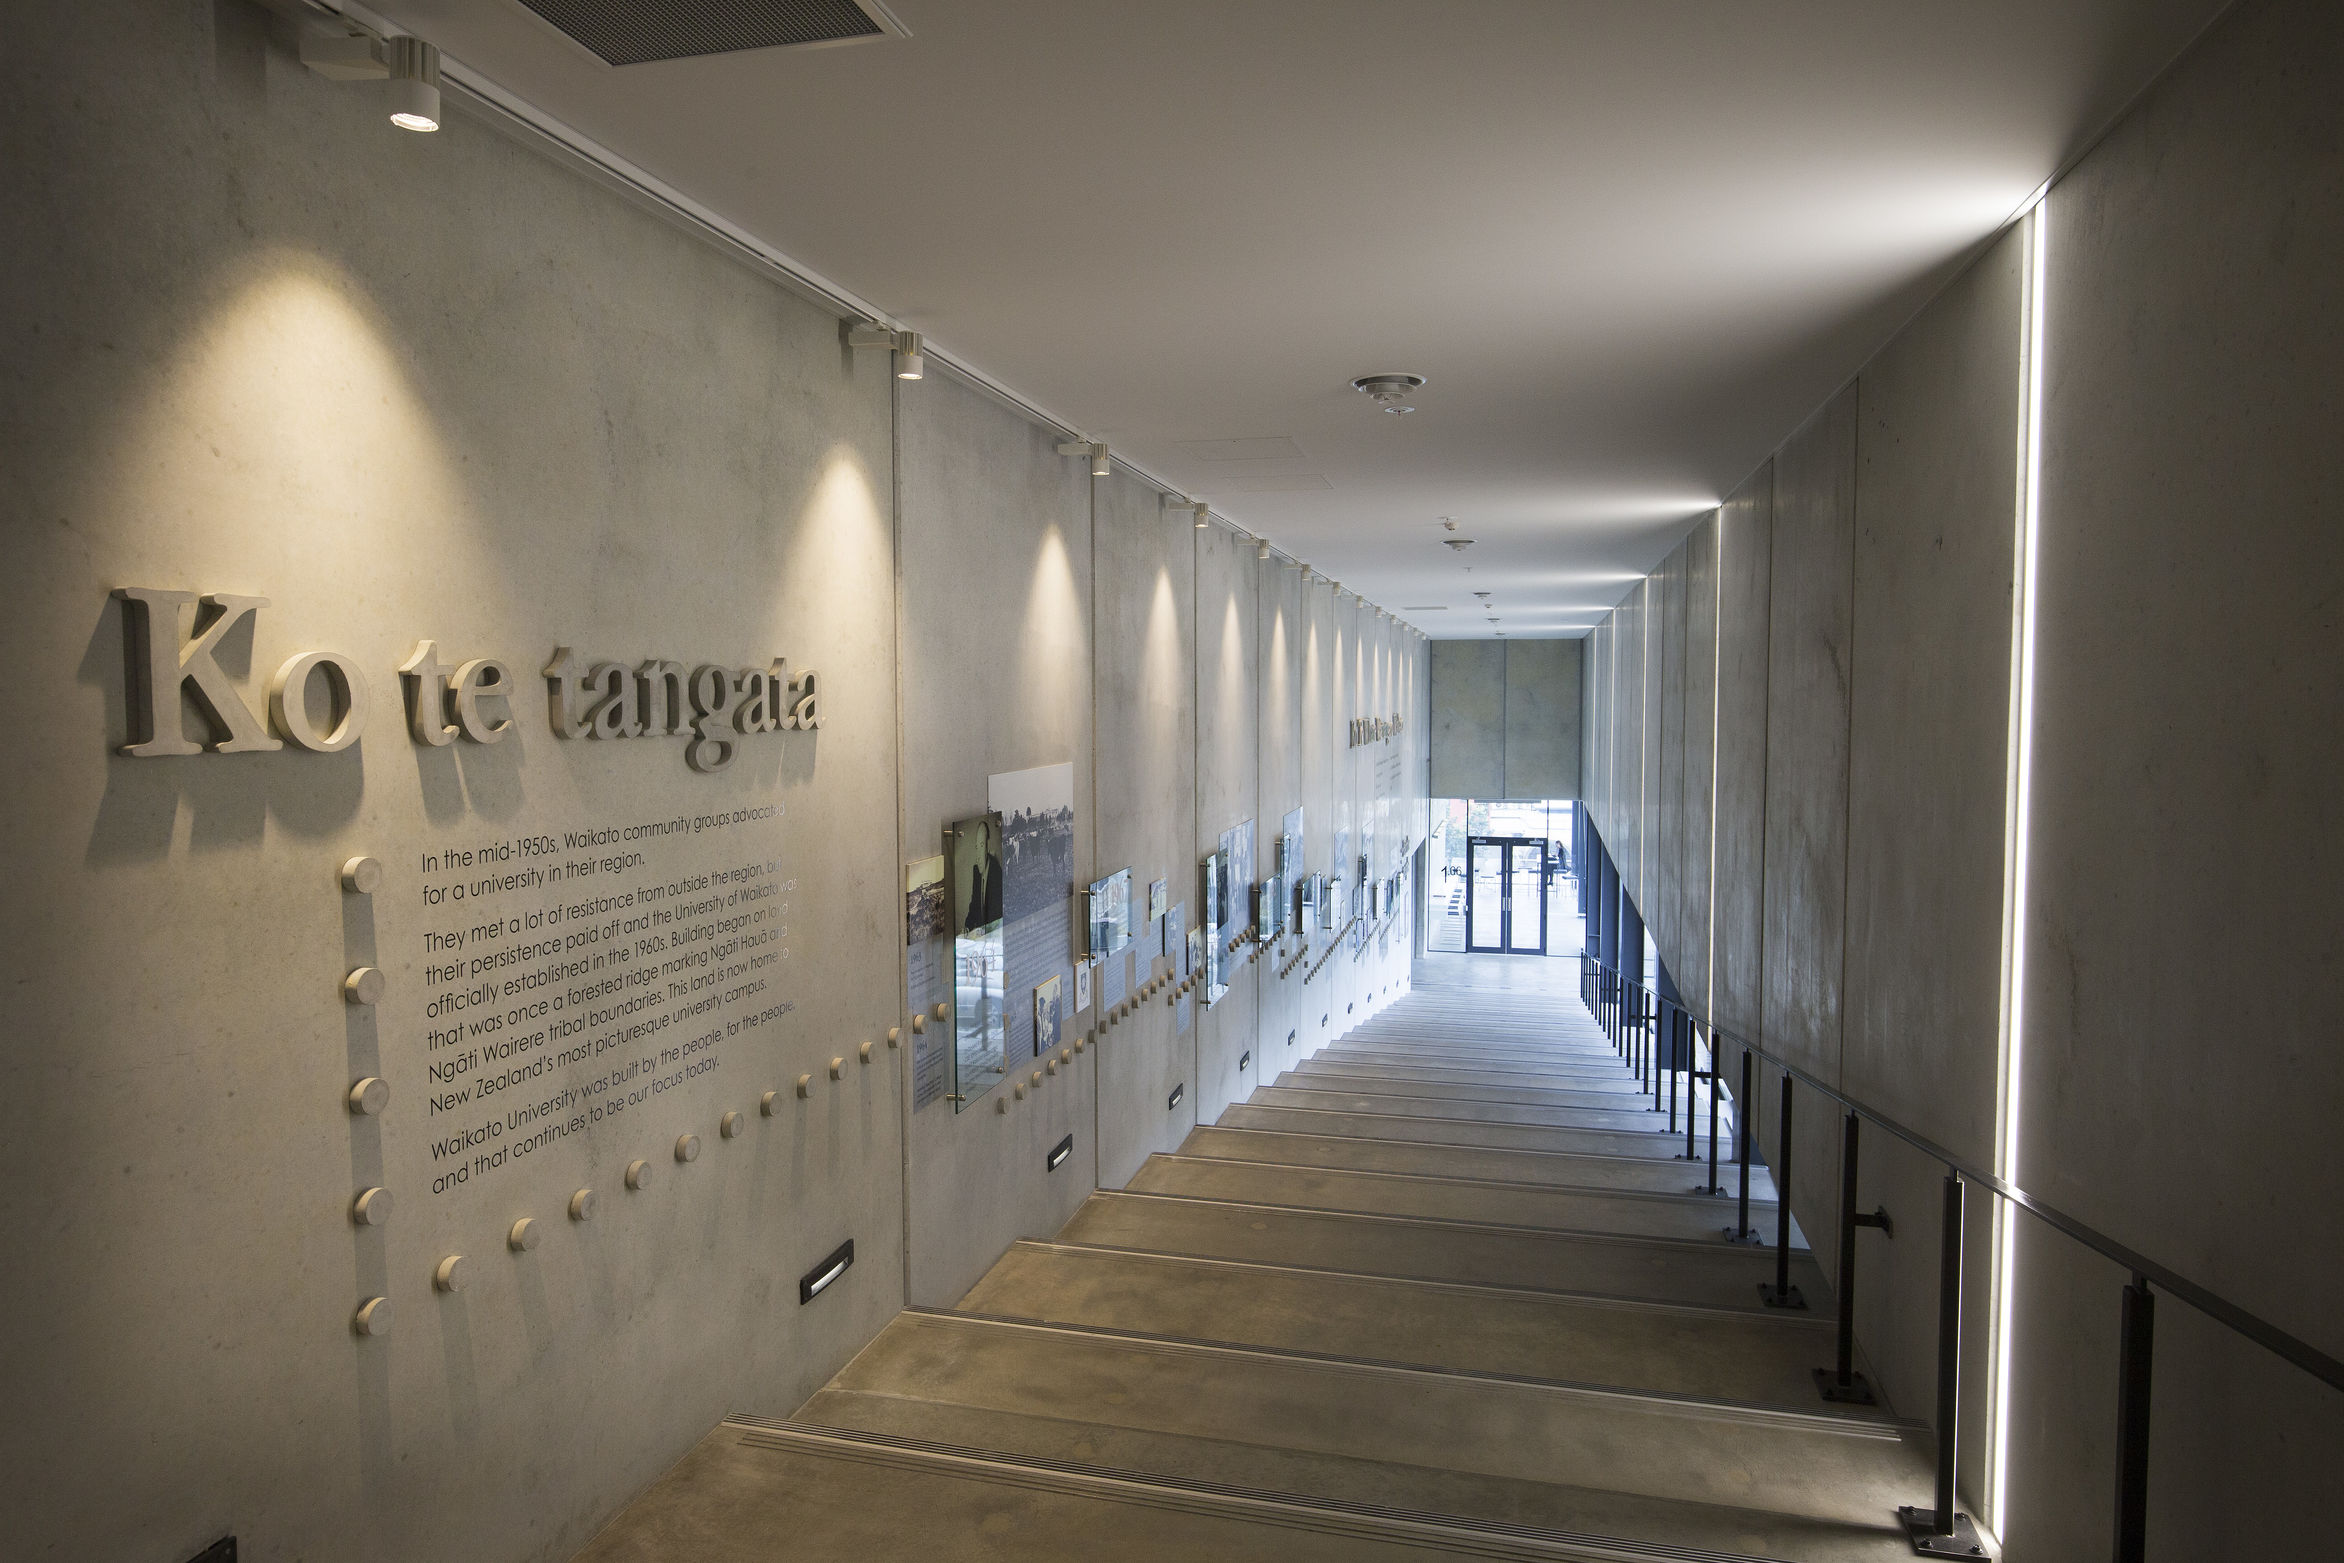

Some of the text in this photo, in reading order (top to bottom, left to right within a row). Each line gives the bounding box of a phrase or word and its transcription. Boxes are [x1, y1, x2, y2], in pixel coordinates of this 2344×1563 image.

[110, 586, 827, 772] Ko te tangata
[422, 801, 785, 873] In the mid-1950s, Waikato community groups advocated
[423, 851, 645, 906] for a university in their region.
[423, 930, 466, 953] They
[471, 917, 504, 943] met
[509, 918, 520, 933] a
[525, 909, 543, 930] lot
[548, 904, 563, 925] of
[567, 893, 634, 920] resistance
[637, 885, 665, 904] from
[668, 874, 709, 897] outside
[712, 871, 729, 886] the
[731, 863, 764, 883] region,
[426, 959, 466, 986] their
[471, 938, 561, 979] persistence
[566, 924, 598, 953] paid
[602, 919, 620, 940] off
[623, 915, 649, 934] and
[652, 909, 672, 926] the
[675, 895, 725, 920] University
[727, 890, 738, 908] of
[740, 882, 778, 903] Waikato
[427, 982, 499, 1018] officially
[504, 955, 589, 996] established
[593, 953, 605, 970] in
[608, 948, 630, 966] the
[635, 936, 668, 958] 1960s.
[671, 923, 714, 947] Building
[717, 914, 751, 933] began
[754, 909, 765, 923] on
[427, 1022, 464, 1051] that
[469, 1014, 502, 1037] was
[507, 1000, 548, 1026] once
[553, 996, 563, 1011] a
[567, 973, 622, 1006] forested
[626, 966, 659, 986] ridge
[662, 951, 708, 977] marking
[710, 937, 739, 961] Ngāti
[741, 930, 767, 951] Hauā
[429, 1049, 478, 1084] Ngāti
[483, 1031, 544, 1063] Wairere
[549, 1012, 586, 1042] tribal
[589, 990, 665, 1027] boundaries.
[668, 980, 688, 999] This
[690, 969, 715, 991] land
[717, 967, 725, 981] is
[727, 962, 749, 979] now
[750, 951, 778, 970] home
[430, 978, 767, 1117] New Zealand's most picturesque university campus.
[431, 1120, 502, 1161] Waikato
[507, 1088, 577, 1130] University
[581, 1077, 608, 1098] was
[612, 1061, 639, 1086] built
[642, 1056, 657, 1074] by
[661, 1047, 680, 1065] the
[682, 1029, 724, 1058] people,
[727, 1022, 740, 1037] for
[743, 1014, 759, 1030] the
[432, 1055, 720, 1194] and that continues to be our focus today.
